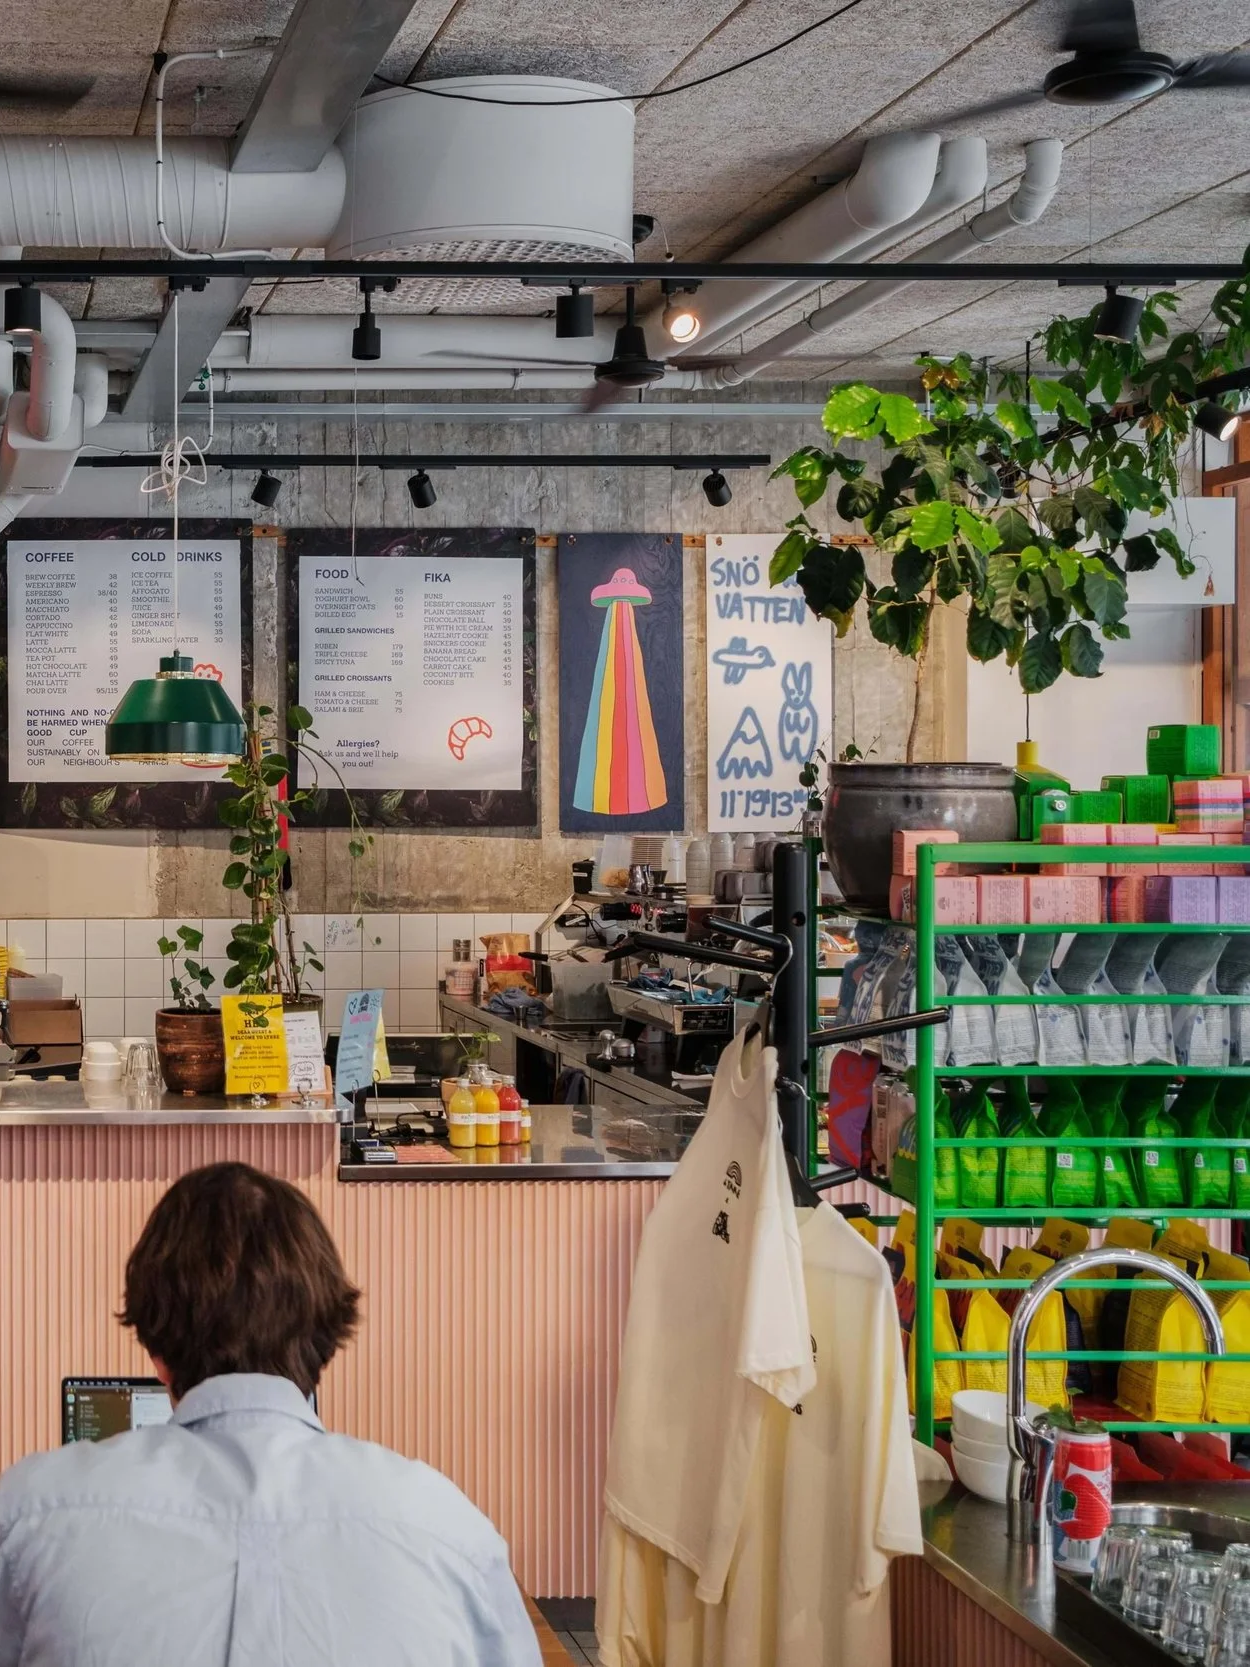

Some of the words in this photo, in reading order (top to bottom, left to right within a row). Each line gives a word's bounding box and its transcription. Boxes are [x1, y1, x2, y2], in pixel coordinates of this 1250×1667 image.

[26, 553, 73, 562] COFFEE
[132, 552, 165, 561] COLD
[177, 552, 222, 562] DRINKS
[316, 569, 348, 578] FOOD
[710, 555, 760, 588] SNÖ
[425, 573, 450, 582] FIKA
[716, 592, 806, 624] VATTEN
[337, 740, 379, 748] Allergies?
[382, 751, 398, 759] help
